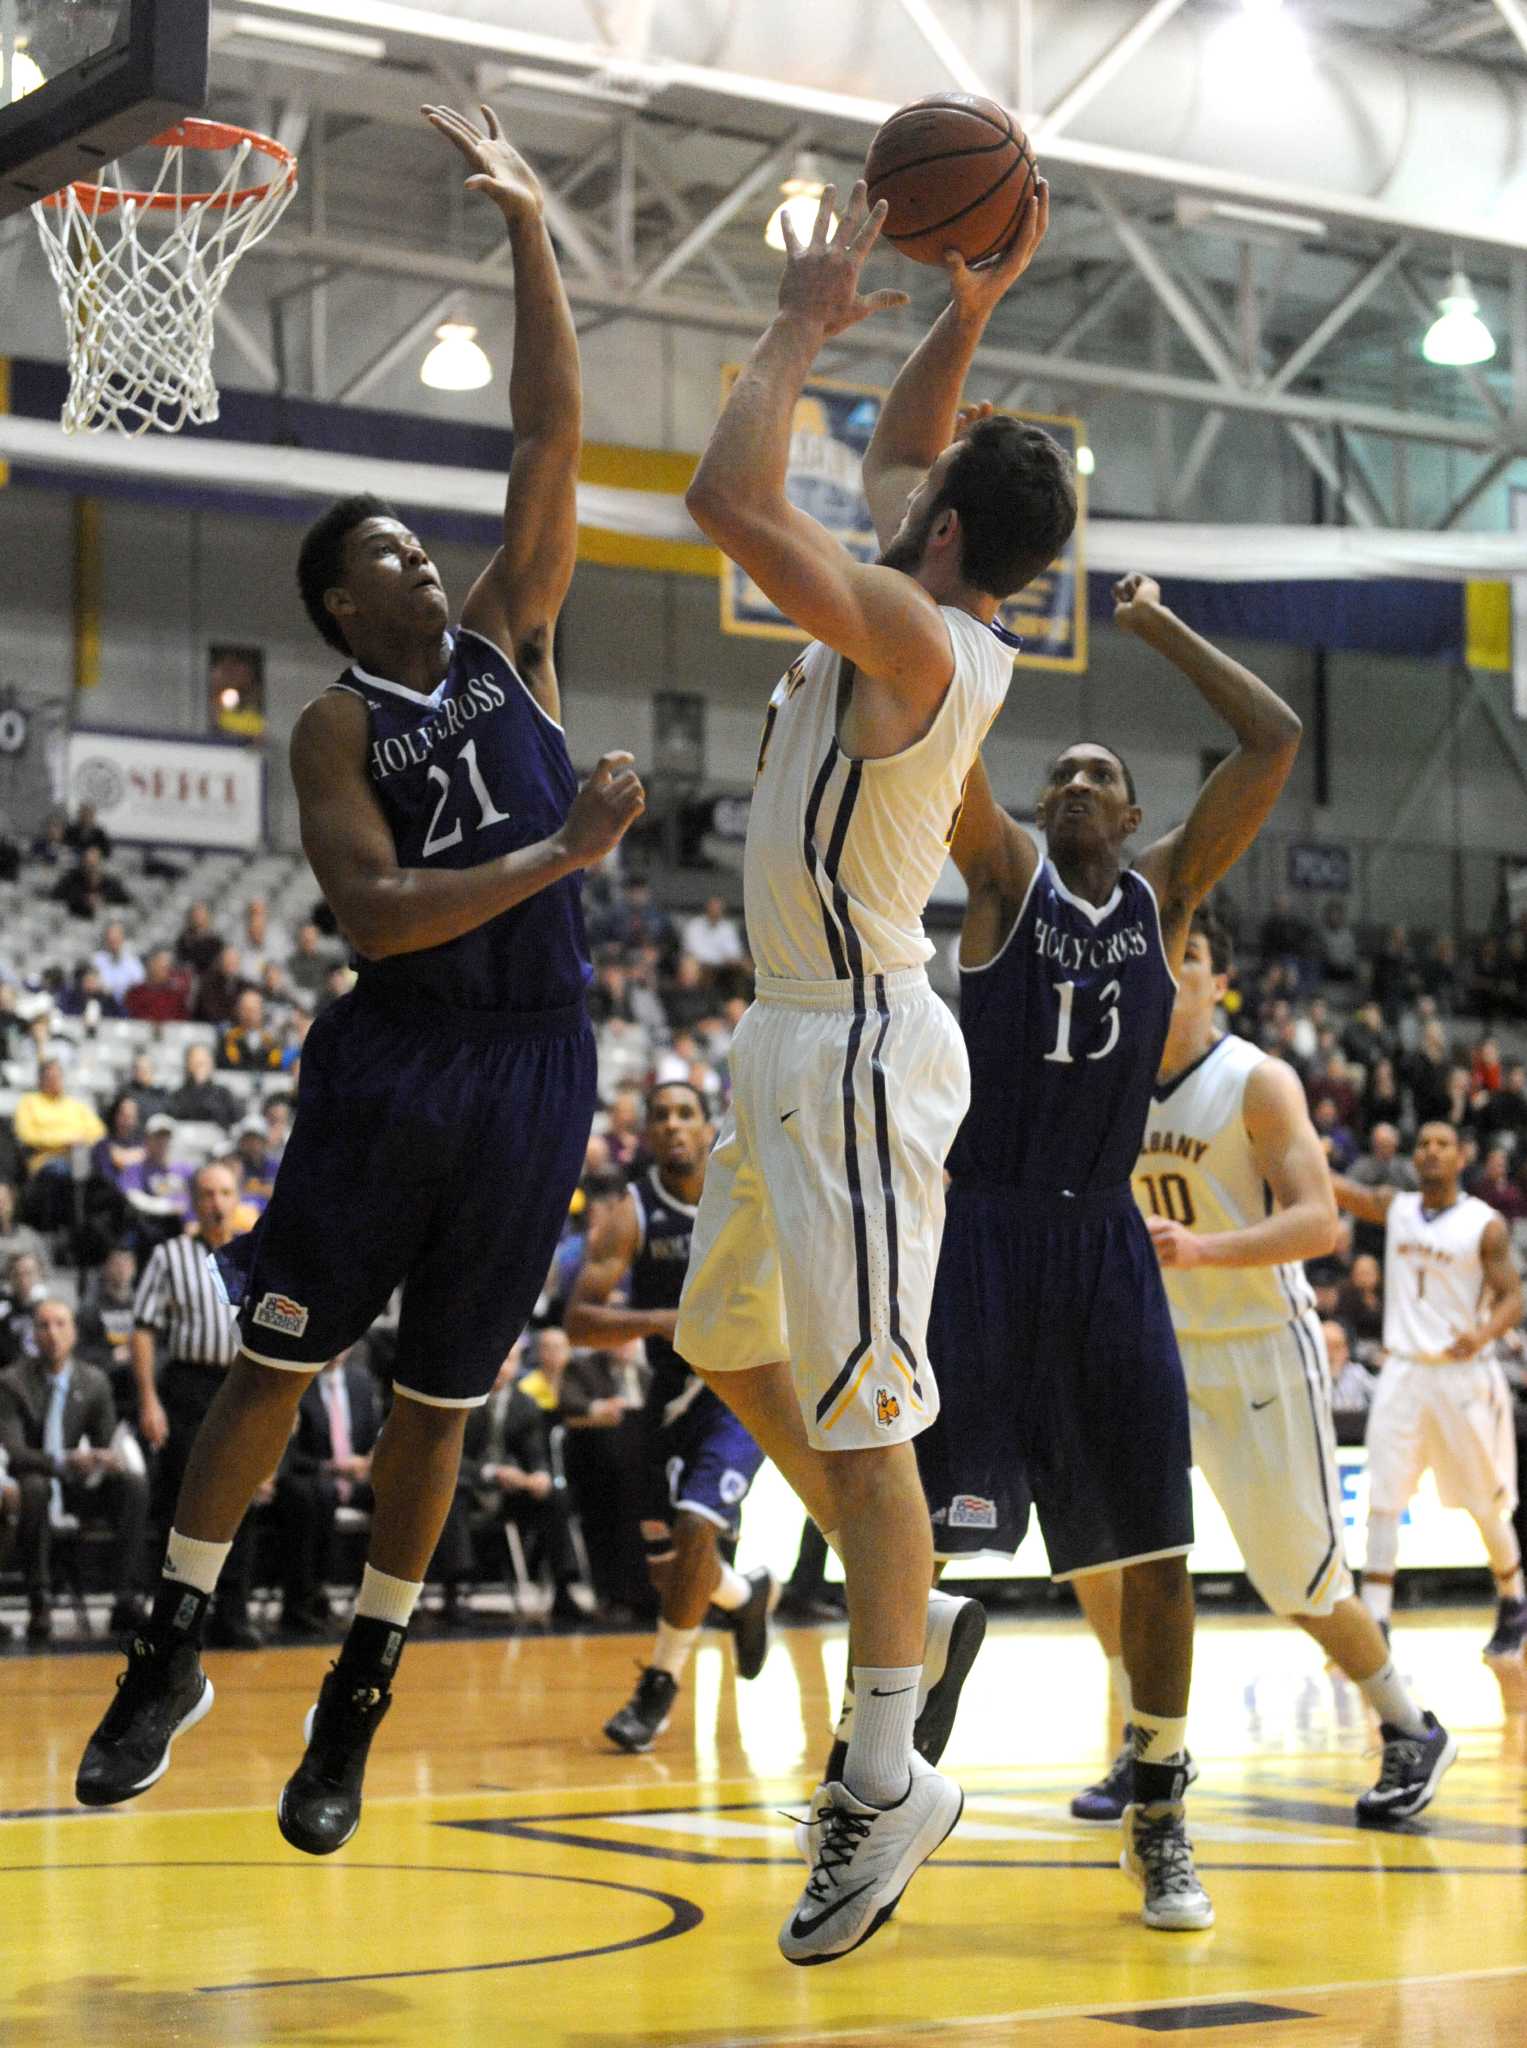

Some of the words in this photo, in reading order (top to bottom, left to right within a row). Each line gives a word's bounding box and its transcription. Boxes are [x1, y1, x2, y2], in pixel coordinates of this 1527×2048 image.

[371, 724, 434, 779] HOLY
[422, 738, 510, 858] 21
[1034, 917, 1088, 970] HOLY
[1043, 979, 1121, 1063] 13
[1139, 1173, 1196, 1225] 10
